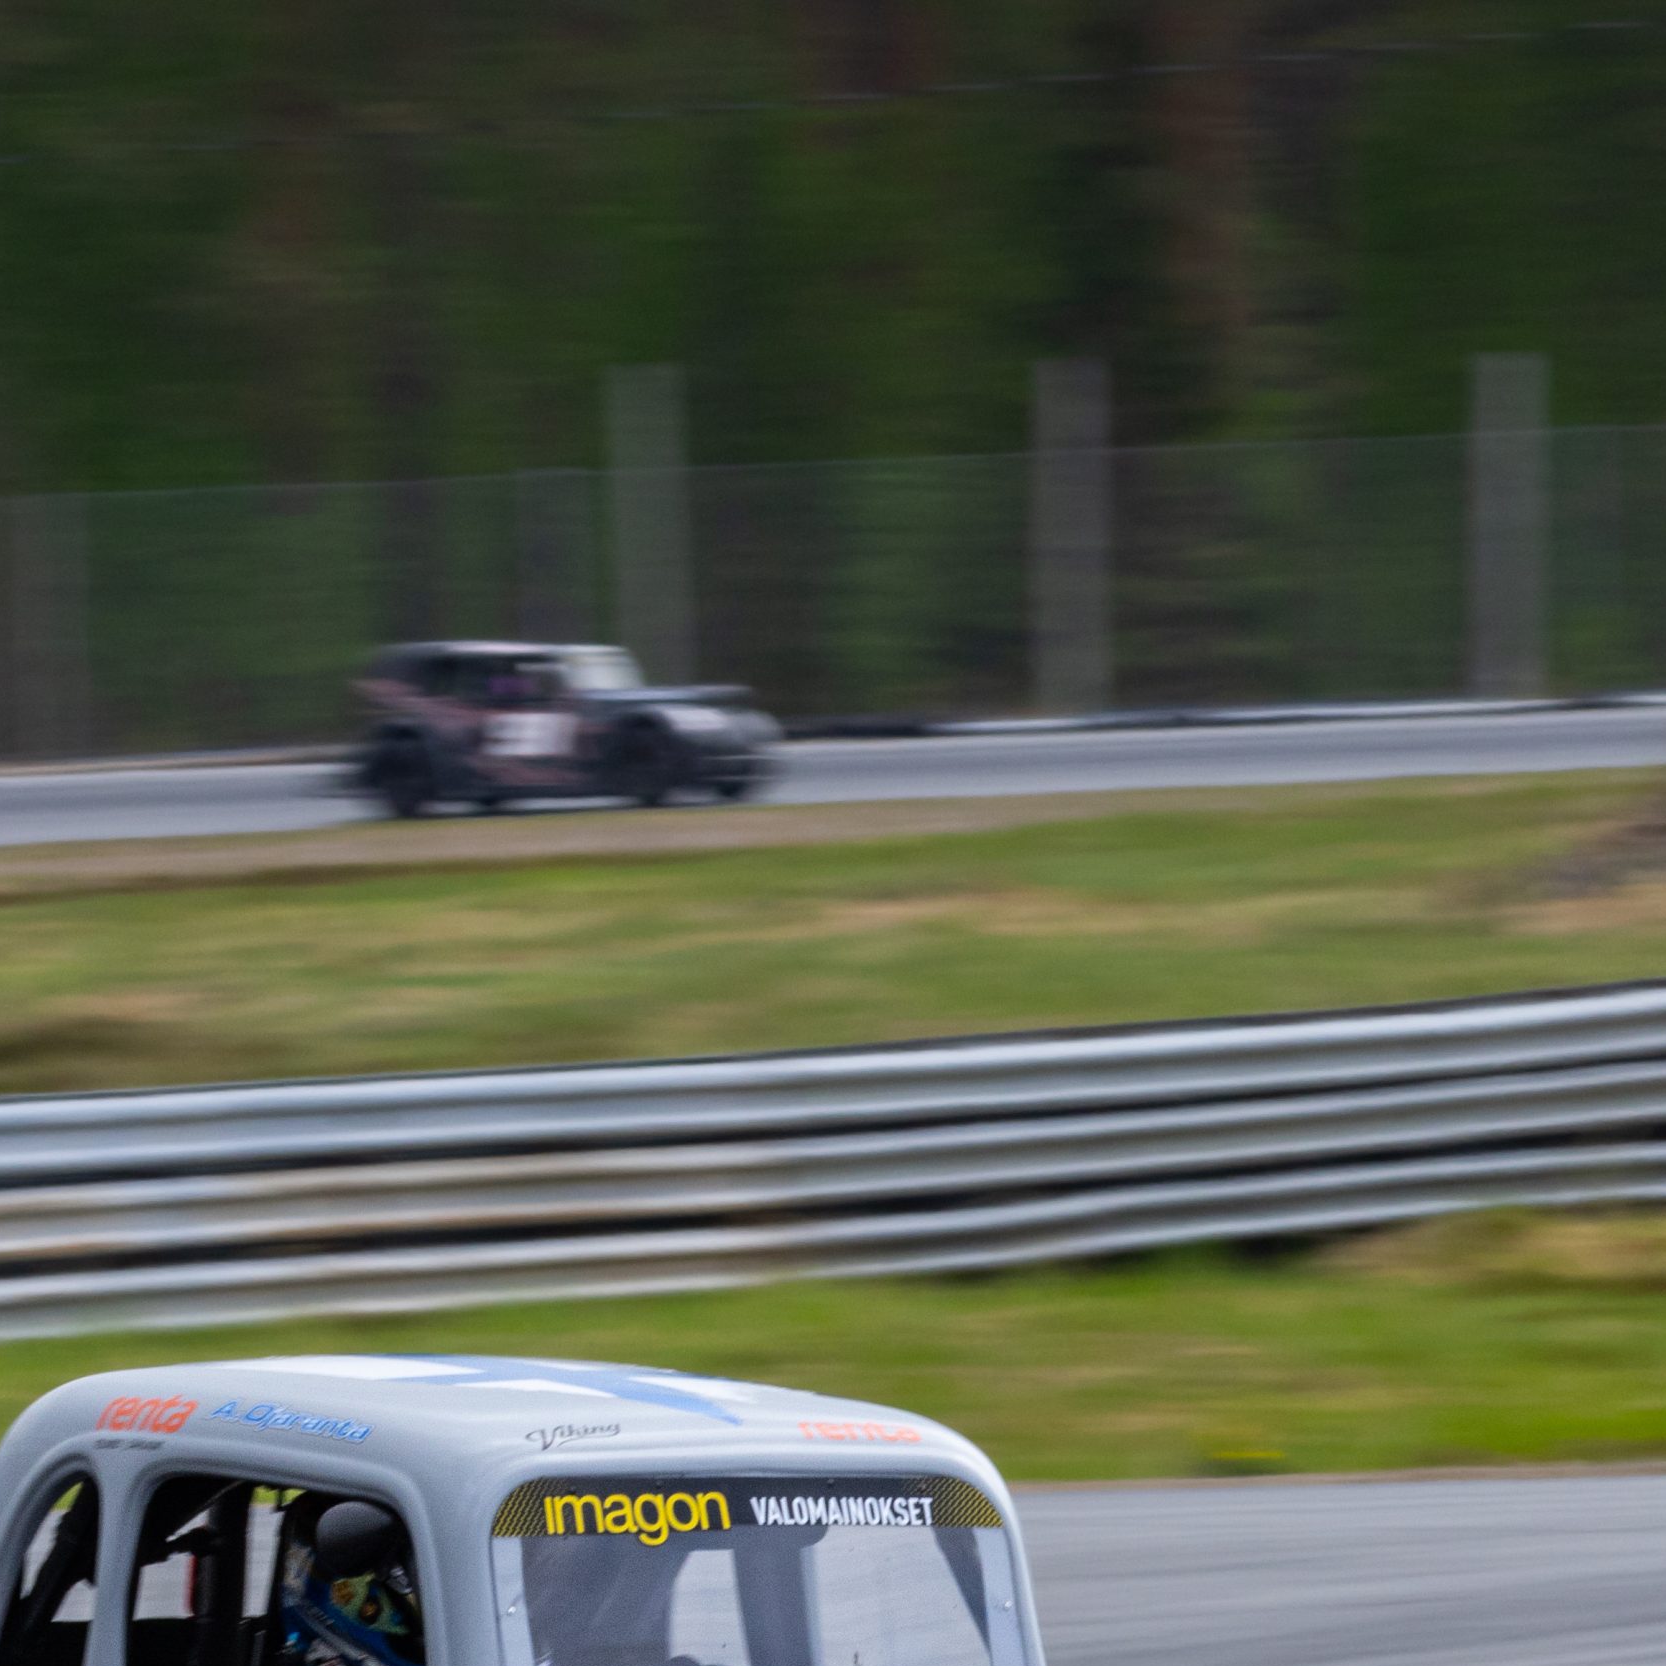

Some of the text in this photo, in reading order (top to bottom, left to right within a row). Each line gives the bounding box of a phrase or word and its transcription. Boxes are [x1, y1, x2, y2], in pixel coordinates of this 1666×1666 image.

[96, 1395, 197, 1434] renta
[525, 1422, 621, 1451] Viking
[544, 1490, 933, 1546] imagon VALOMAINOKSET
